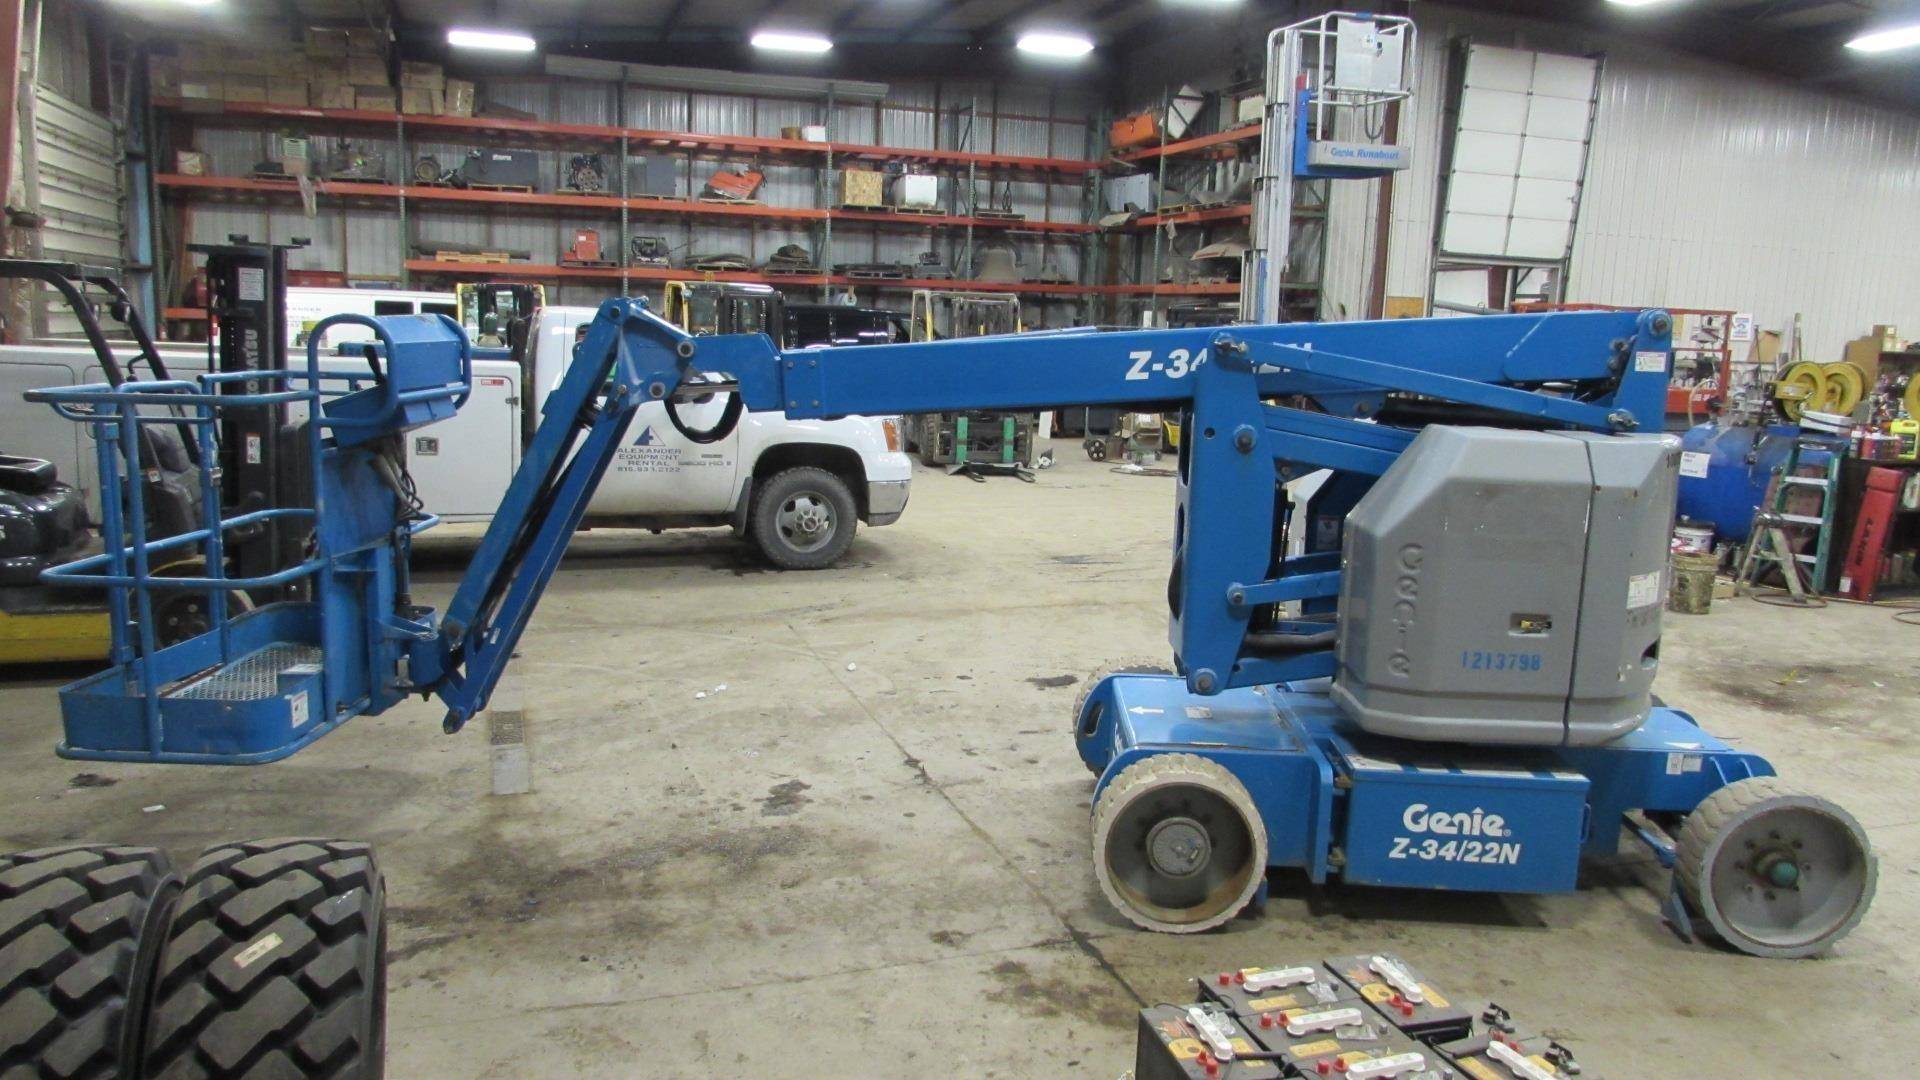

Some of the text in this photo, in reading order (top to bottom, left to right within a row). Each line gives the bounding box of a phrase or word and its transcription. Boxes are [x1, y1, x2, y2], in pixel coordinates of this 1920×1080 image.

[245, 328, 259, 395] OATSU
[616, 447, 682, 455] ALEXANDER
[1460, 650, 1541, 671] 1213798
[1402, 803, 1505, 837] Genie
[1389, 837, 1521, 865] Z-34/22N
